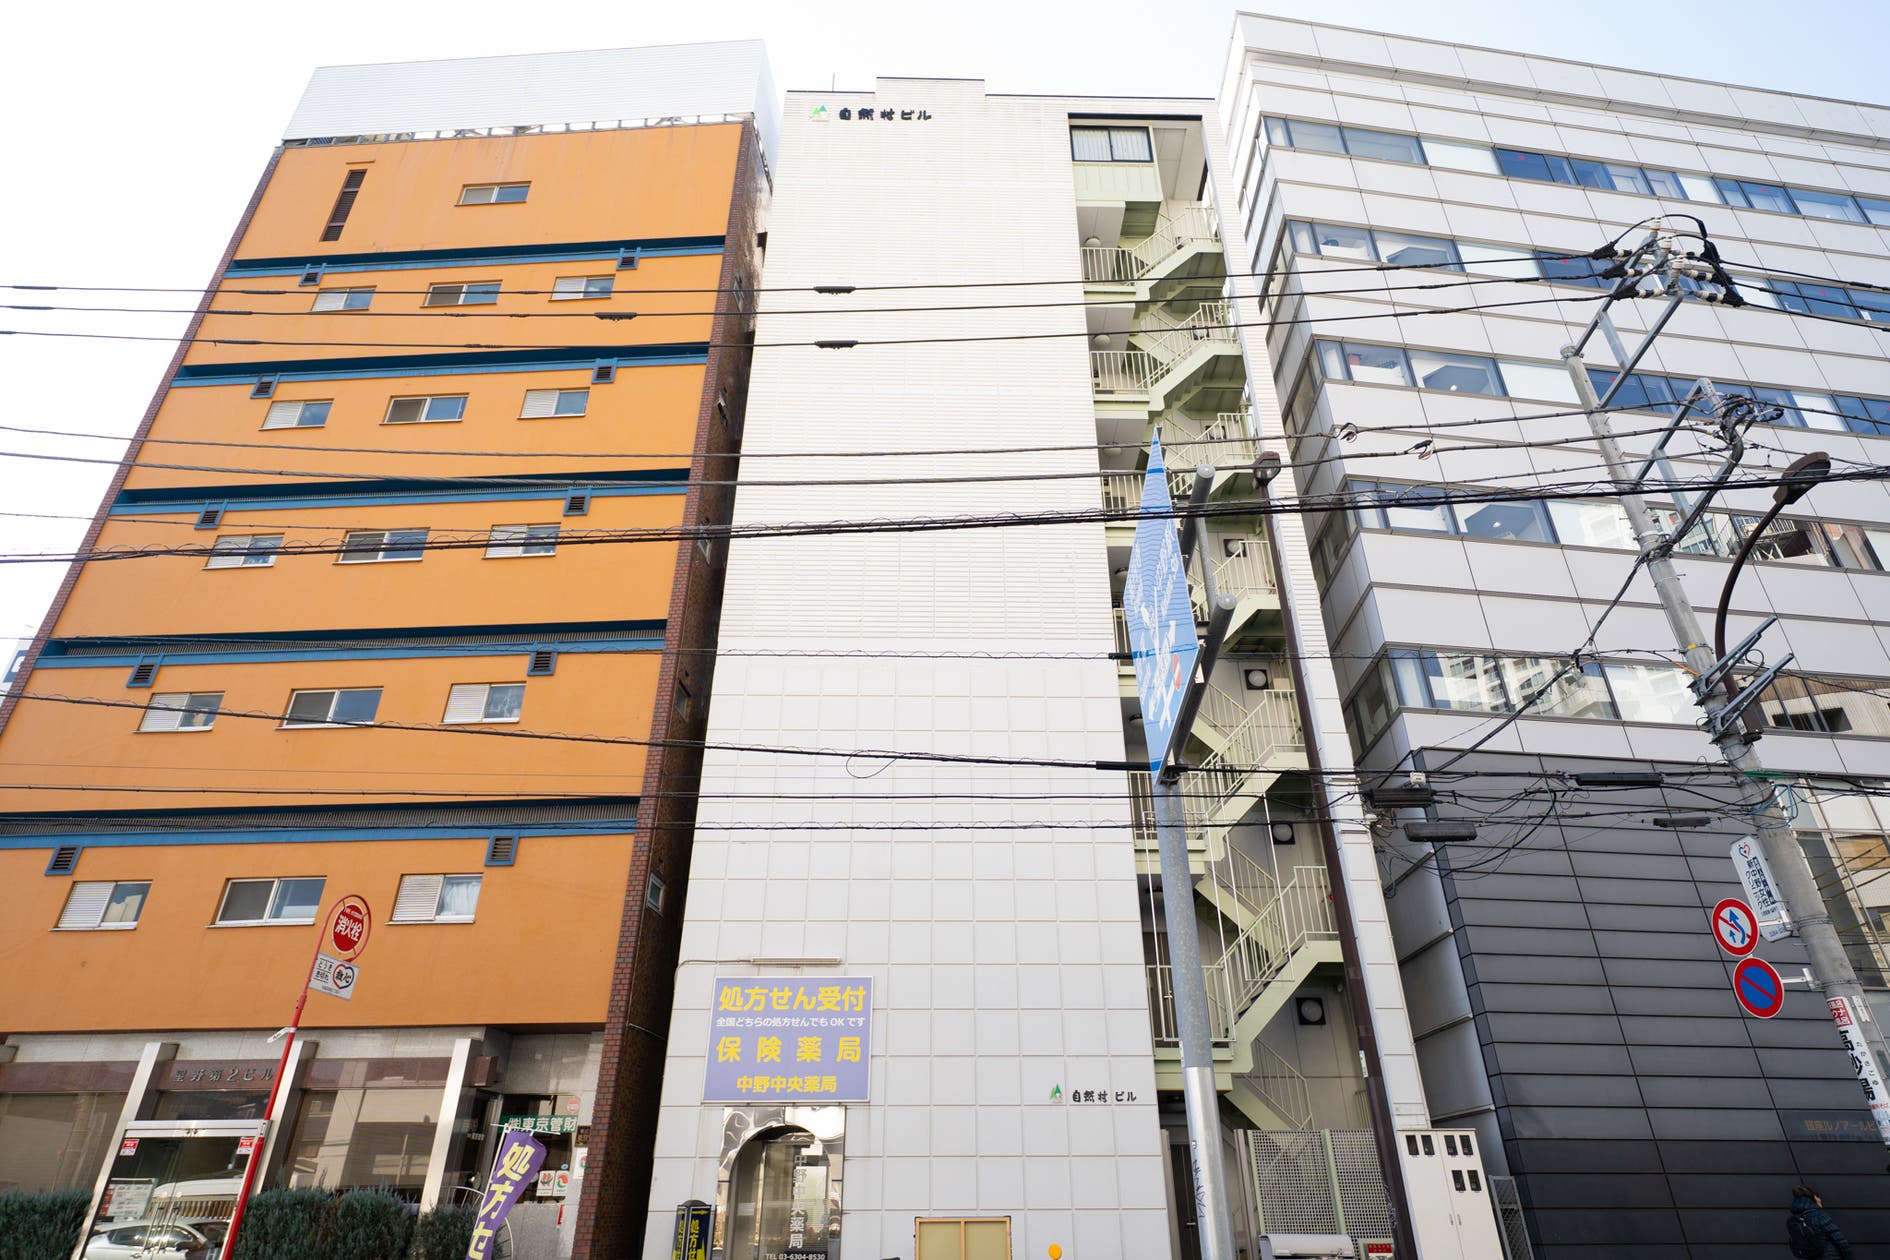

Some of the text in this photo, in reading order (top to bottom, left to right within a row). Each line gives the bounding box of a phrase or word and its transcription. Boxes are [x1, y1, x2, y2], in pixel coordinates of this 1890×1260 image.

[839, 107, 932, 121] 自然村ビル
[335, 914, 362, 941] 消火栓
[335, 969, 352, 983] 救心
[718, 985, 867, 1012] 処方せん受付
[716, 1035, 862, 1064] 保険薬局
[736, 1075, 838, 1094] 中野中央薬局
[469, 1142, 536, 1260] 処方せ
